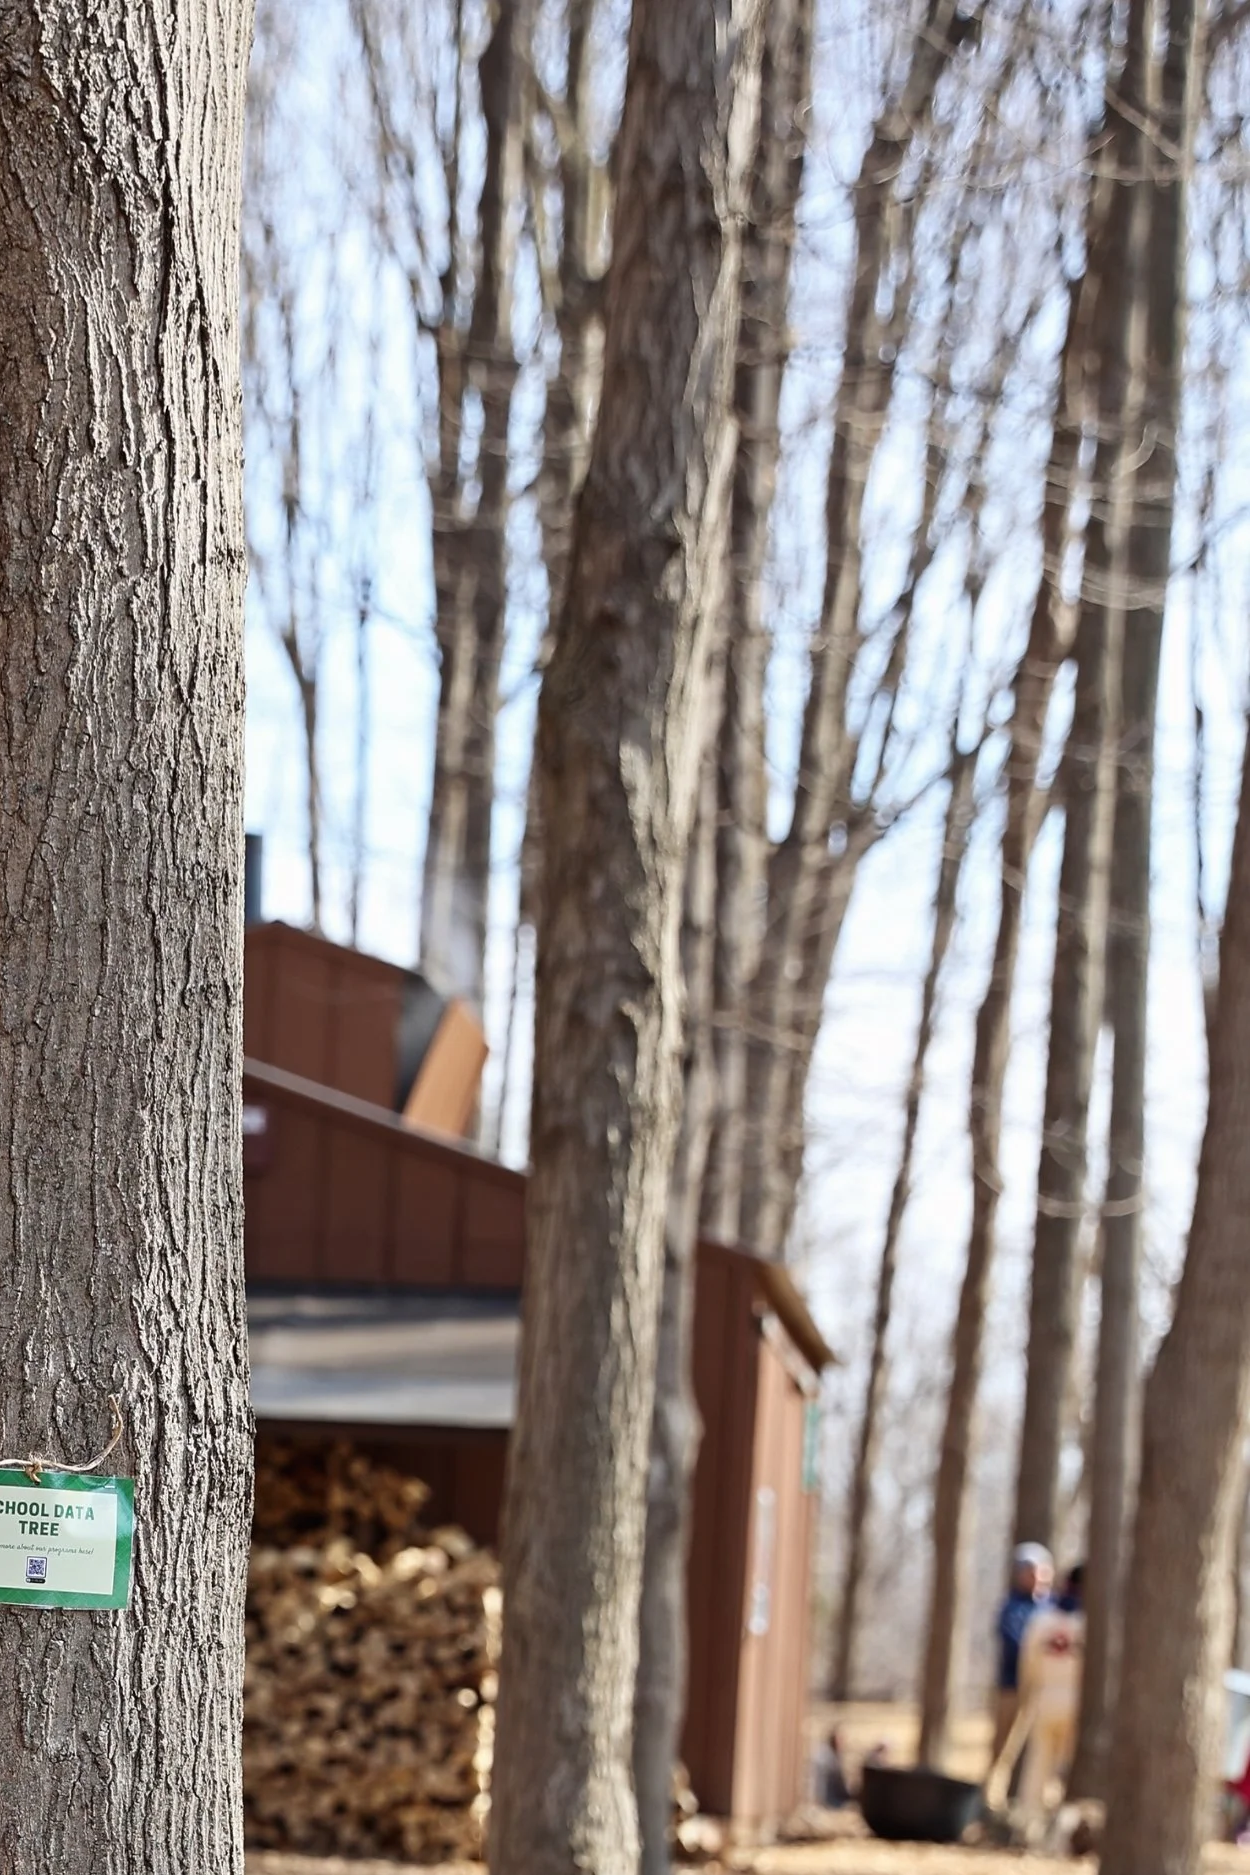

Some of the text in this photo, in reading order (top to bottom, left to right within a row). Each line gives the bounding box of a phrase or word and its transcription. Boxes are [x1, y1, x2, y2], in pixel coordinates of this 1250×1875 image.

[54, 1504, 94, 1520] DATA
[18, 1520, 59, 1536] TREE
[16, 1543, 35, 1551] about
